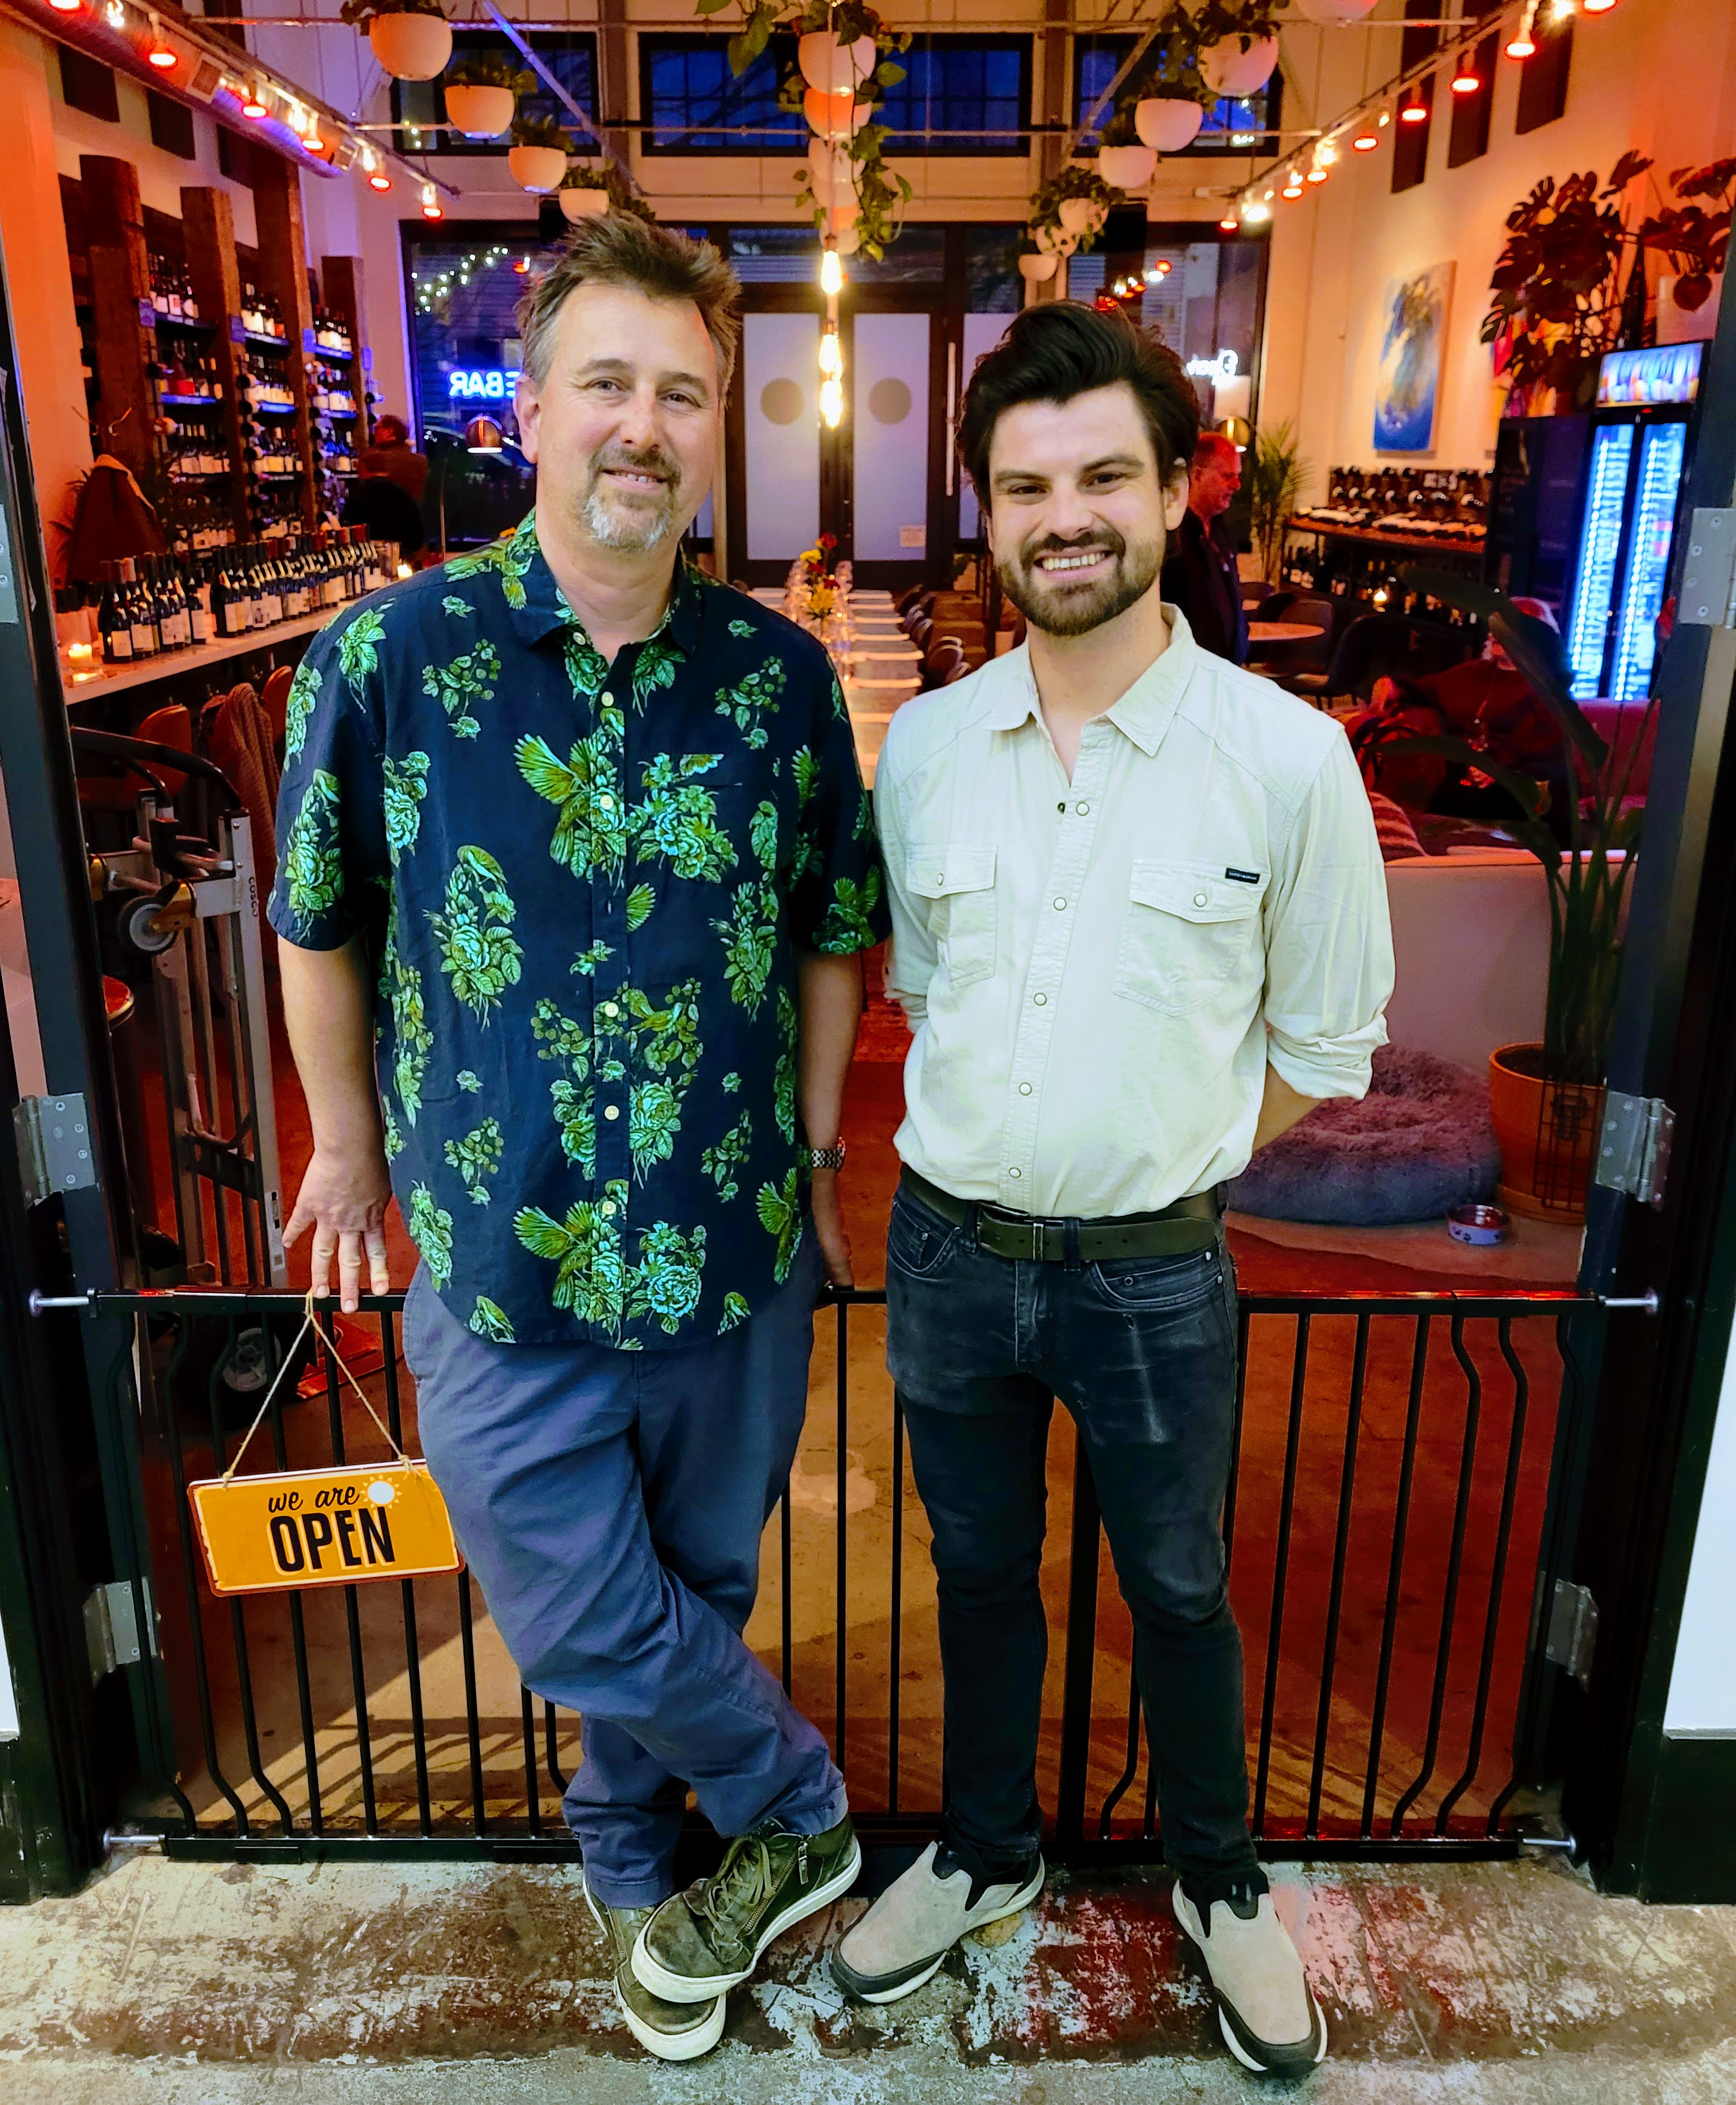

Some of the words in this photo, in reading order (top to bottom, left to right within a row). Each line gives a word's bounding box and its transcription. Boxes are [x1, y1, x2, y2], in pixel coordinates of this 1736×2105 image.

[248, 876, 258, 917] COSCO
[269, 1491, 303, 1513] we
[315, 1486, 360, 1508] are
[269, 1506, 395, 1572] OPEN
